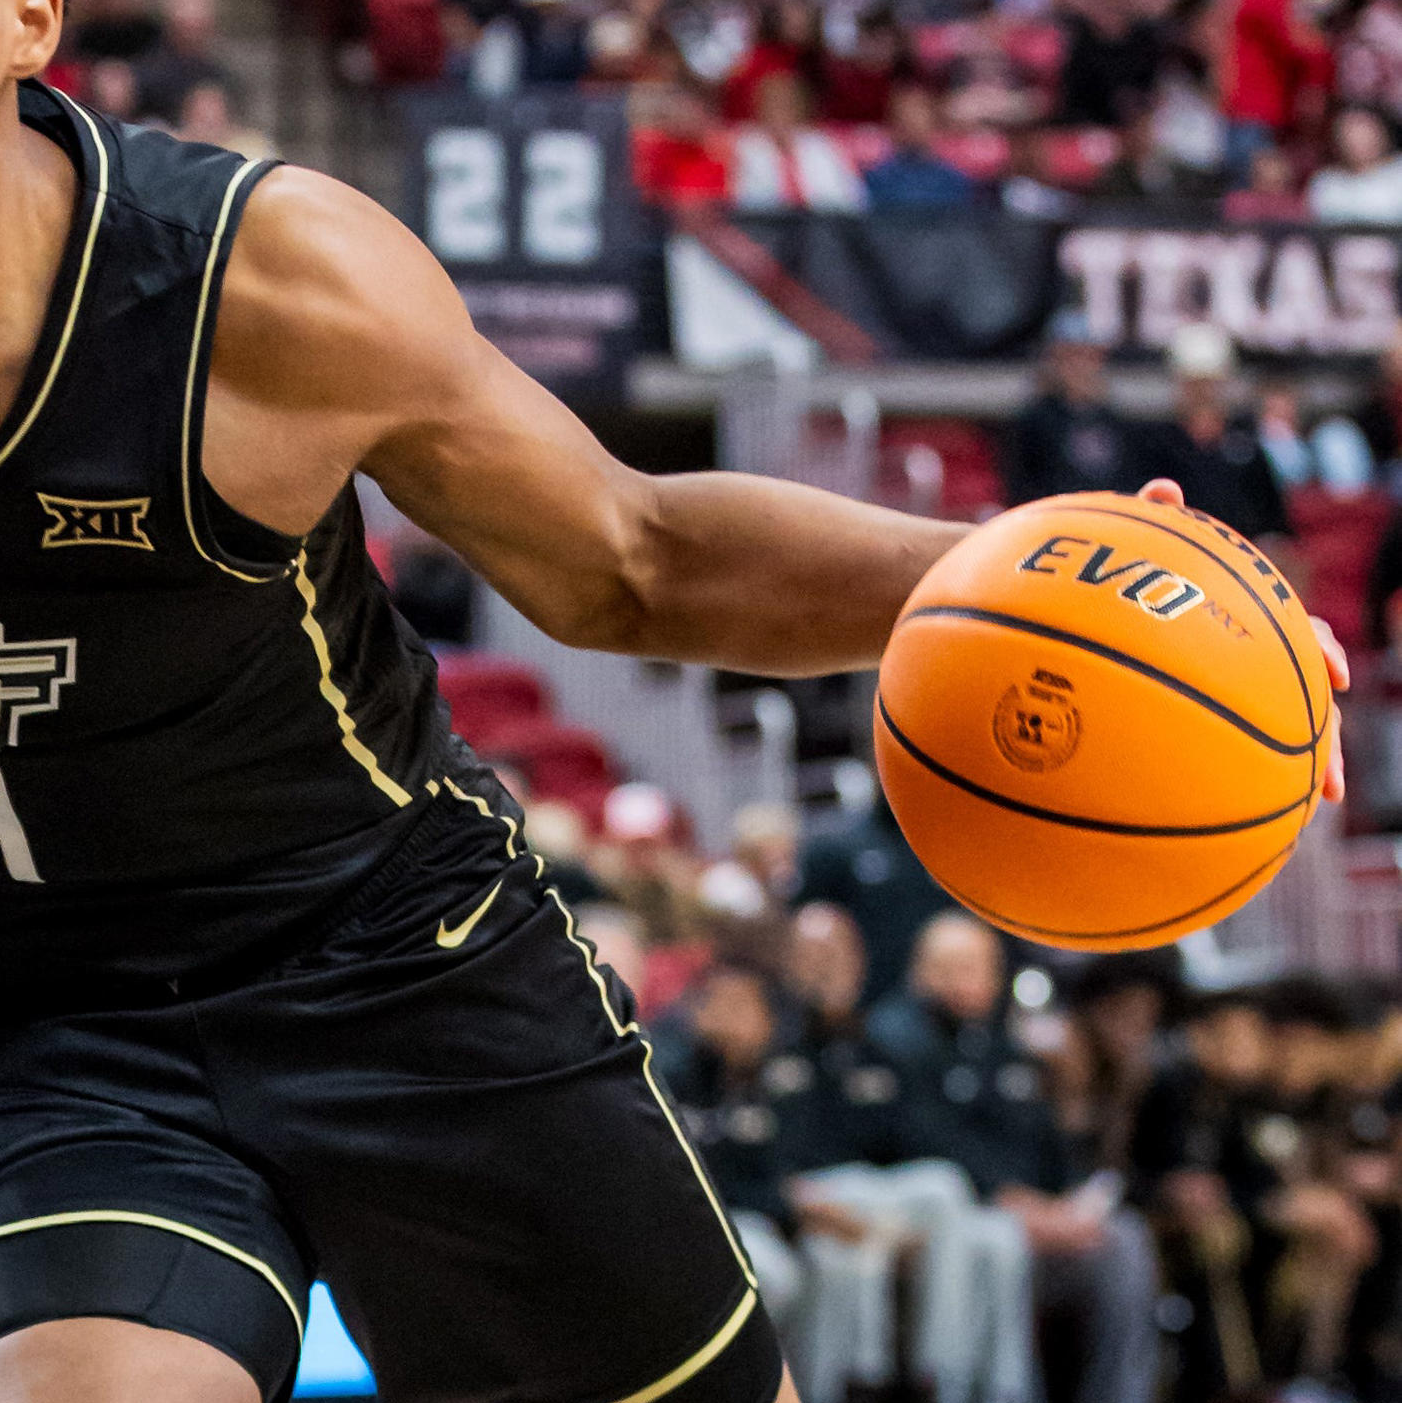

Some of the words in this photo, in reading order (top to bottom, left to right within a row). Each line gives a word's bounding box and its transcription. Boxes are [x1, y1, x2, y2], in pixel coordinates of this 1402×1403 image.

[426, 128, 602, 265] 22
[1060, 230, 1402, 352] TEXAS
[37, 492, 155, 551] XII
[1016, 535, 1206, 621] EVO
